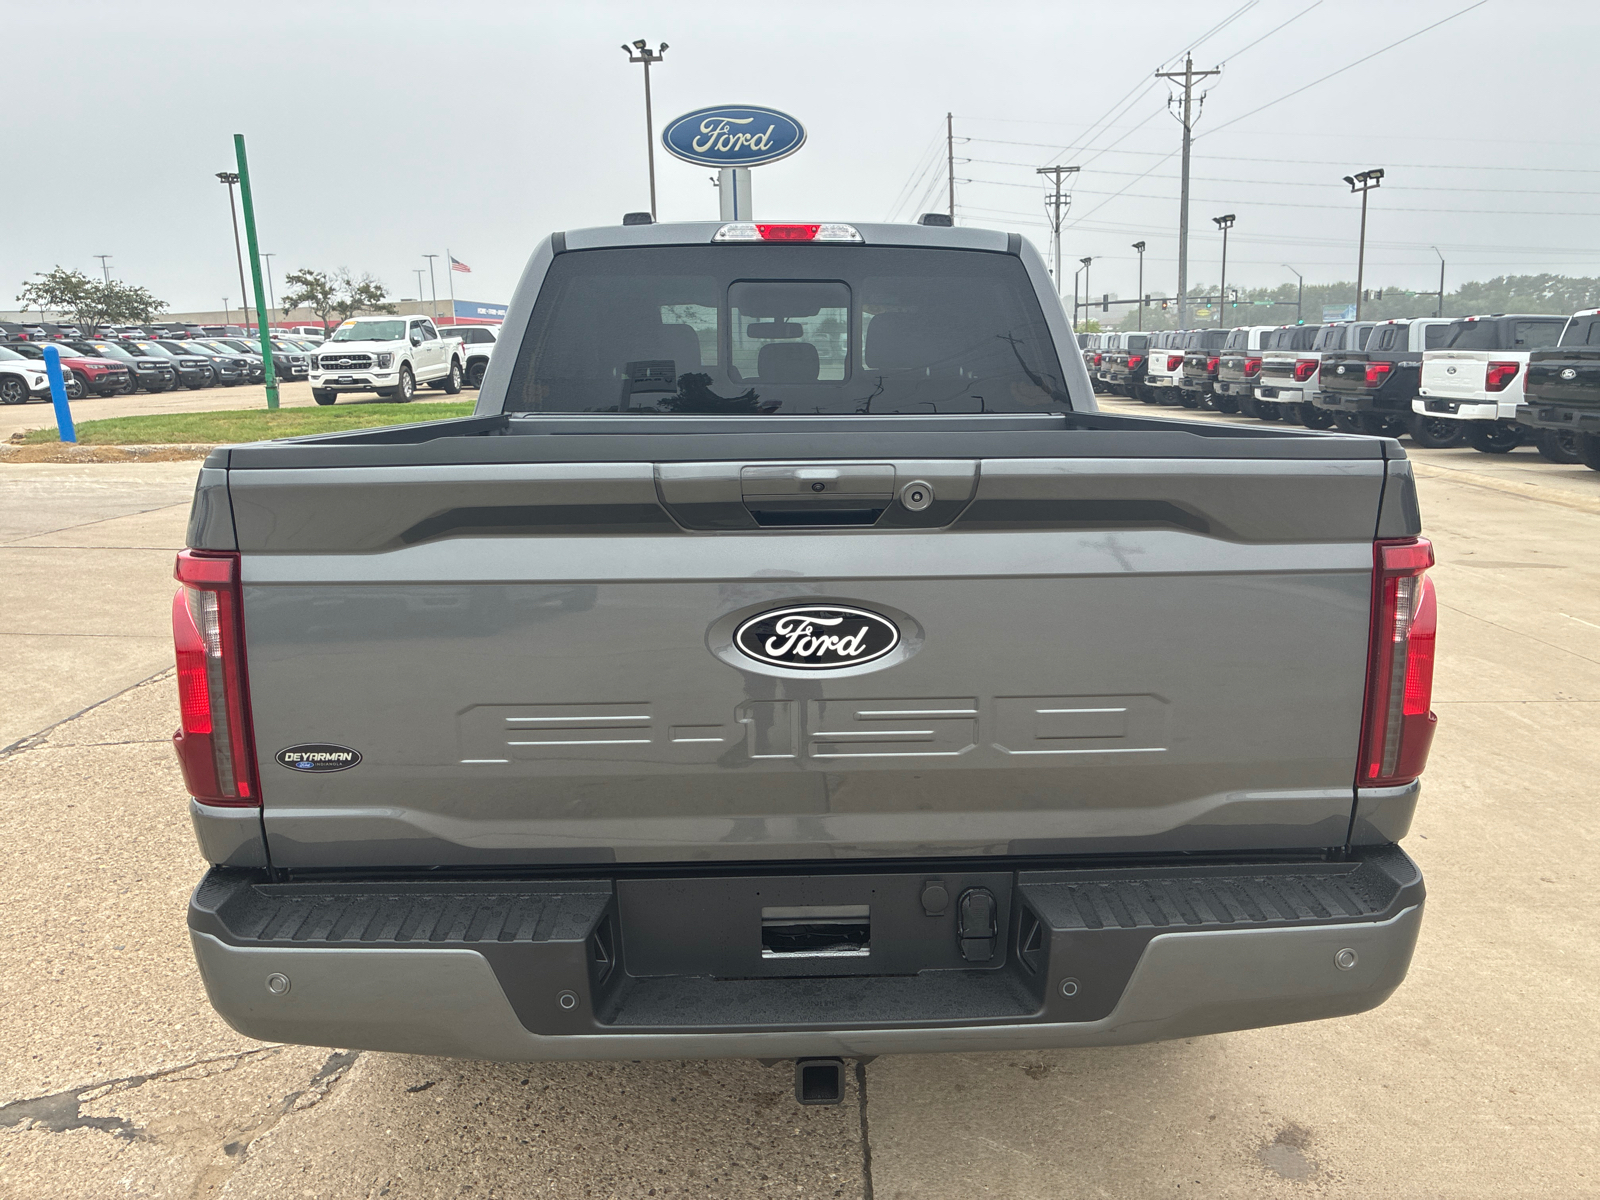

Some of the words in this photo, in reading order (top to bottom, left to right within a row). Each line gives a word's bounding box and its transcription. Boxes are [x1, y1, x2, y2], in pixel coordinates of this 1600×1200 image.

[692, 117, 775, 153] Ford
[764, 615, 869, 657] Ford
[285, 752, 352, 761] DEYARMAN
